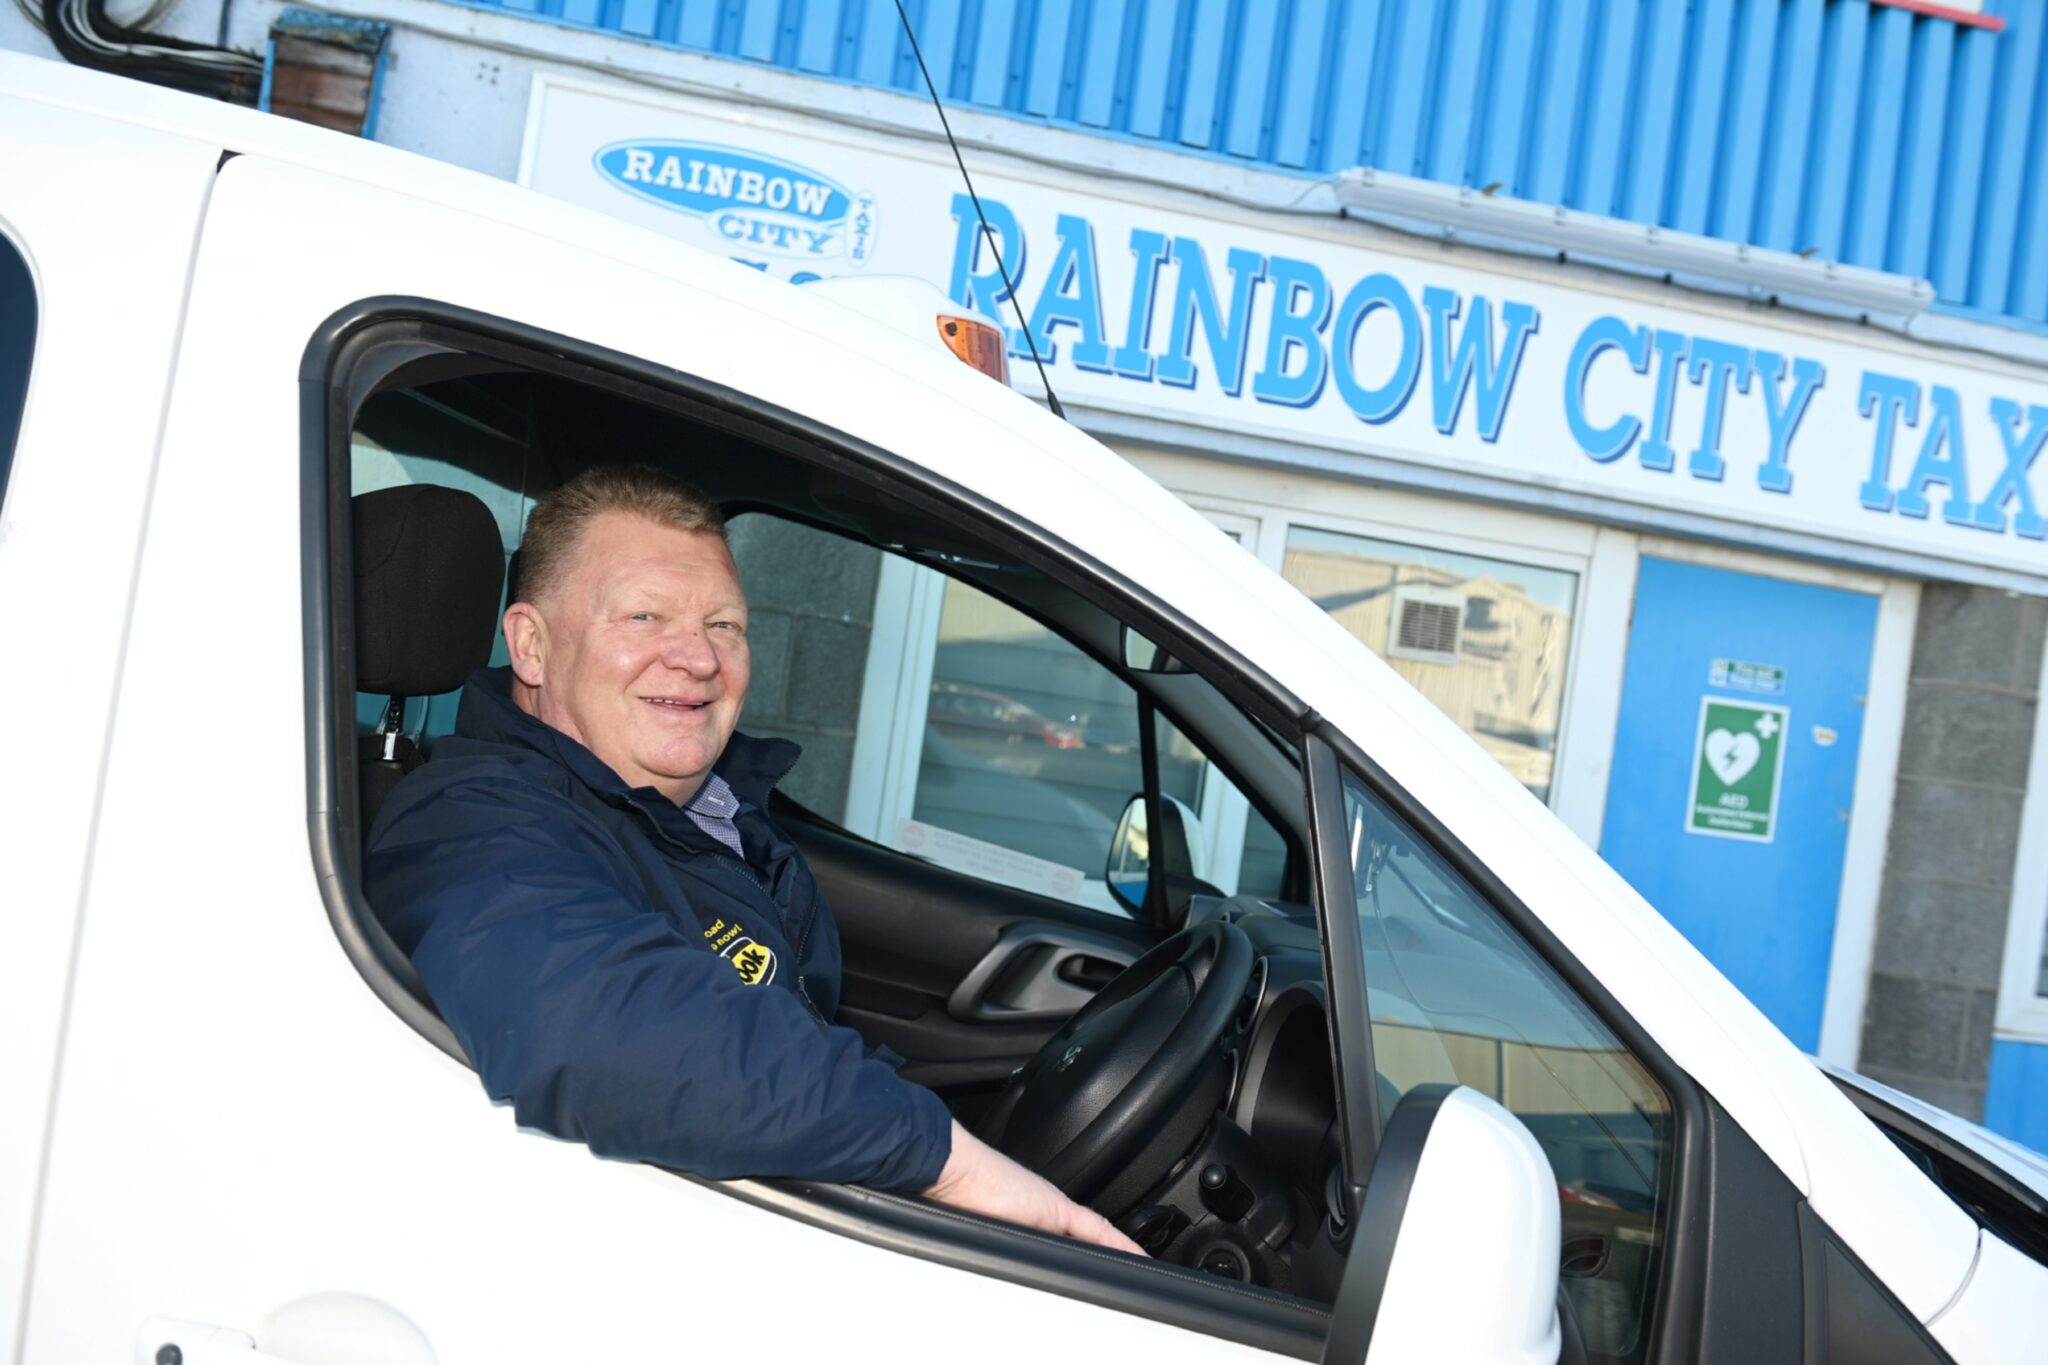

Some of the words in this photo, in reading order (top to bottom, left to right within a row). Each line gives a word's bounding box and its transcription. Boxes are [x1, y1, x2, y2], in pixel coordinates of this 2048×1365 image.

[621, 147, 832, 216] RAINBOW
[717, 213, 835, 254] CITY
[948, 191, 1541, 444] RAINBOW
[1563, 315, 1827, 495] CITY
